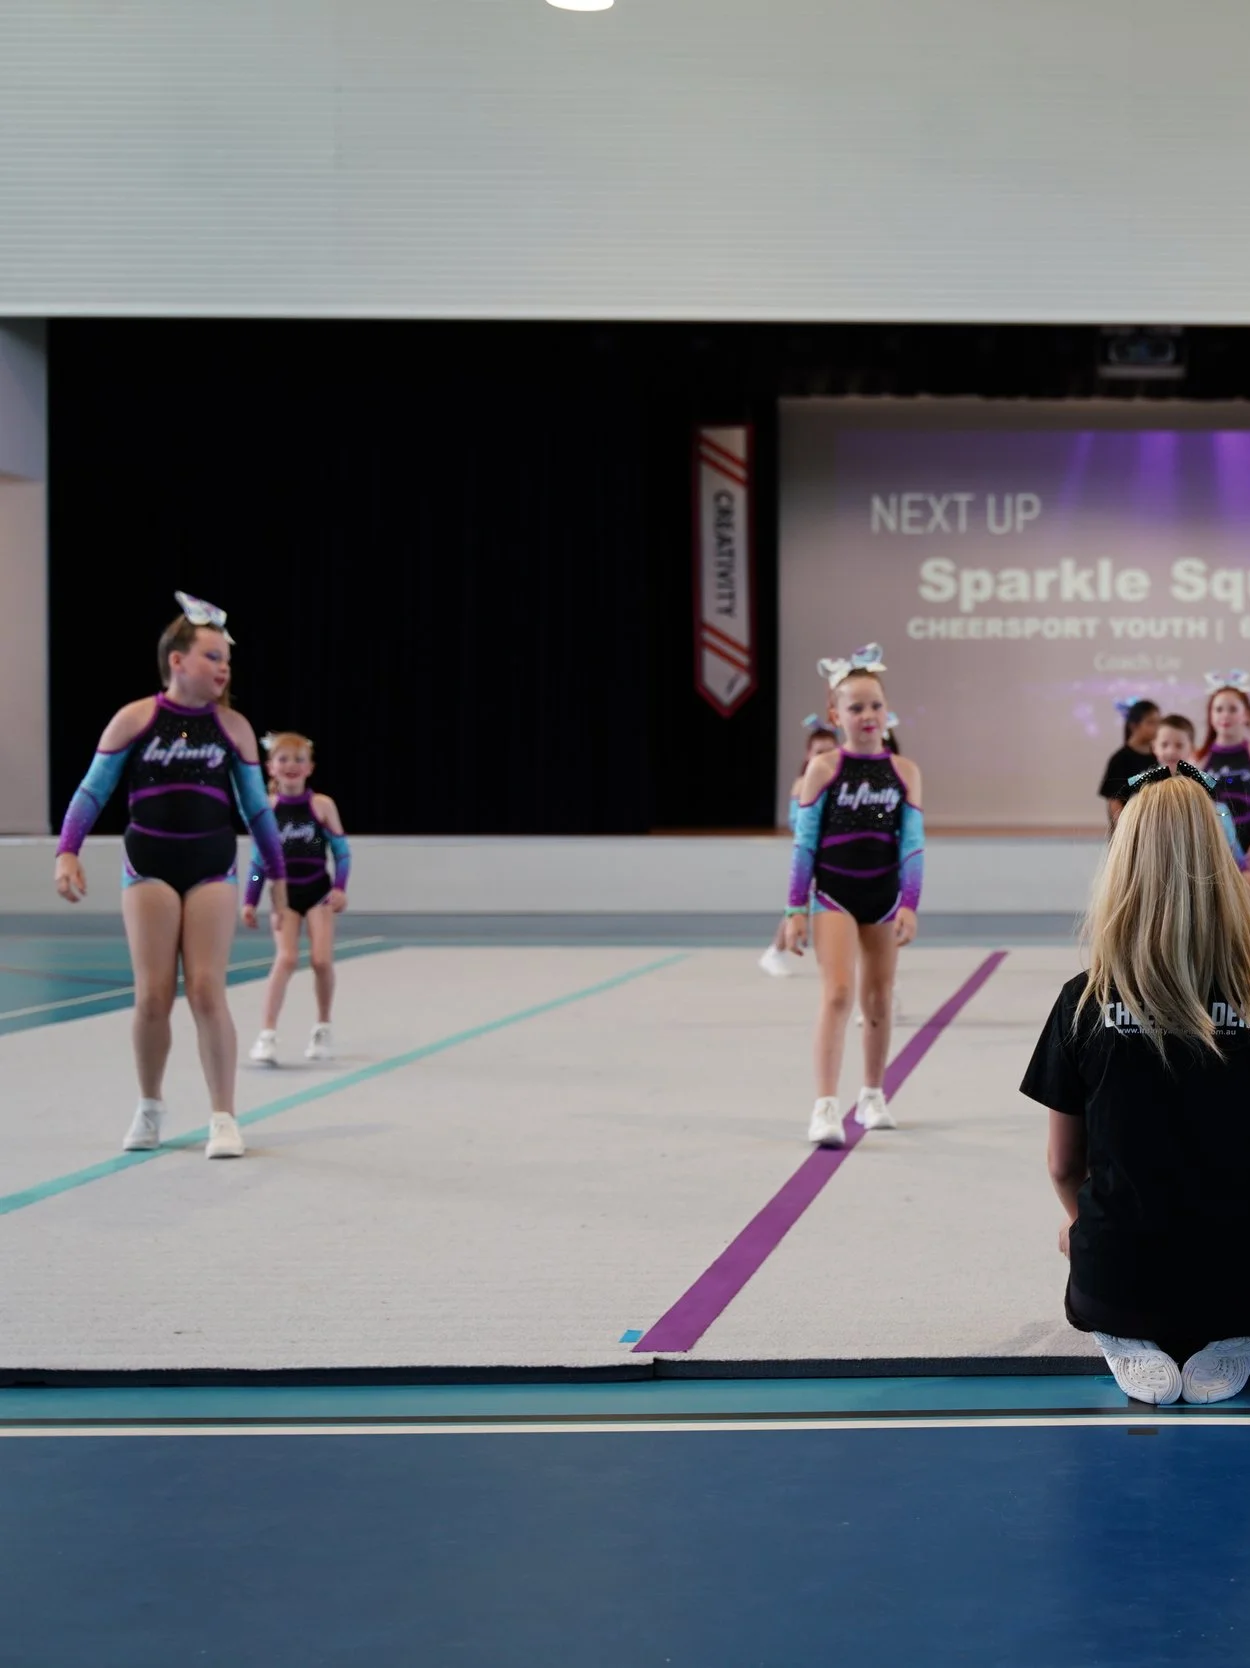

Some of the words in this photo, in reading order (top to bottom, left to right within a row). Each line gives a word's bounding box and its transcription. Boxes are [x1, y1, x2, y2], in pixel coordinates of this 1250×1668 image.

[870, 492, 976, 535] NEXT
[986, 492, 1042, 535] UP
[713, 488, 736, 619] CREATIVITY
[918, 556, 1150, 613] Sparkle
[906, 616, 1100, 641] CHEERSPORT
[1109, 616, 1209, 640] YOUTH
[143, 736, 226, 768] Infinity
